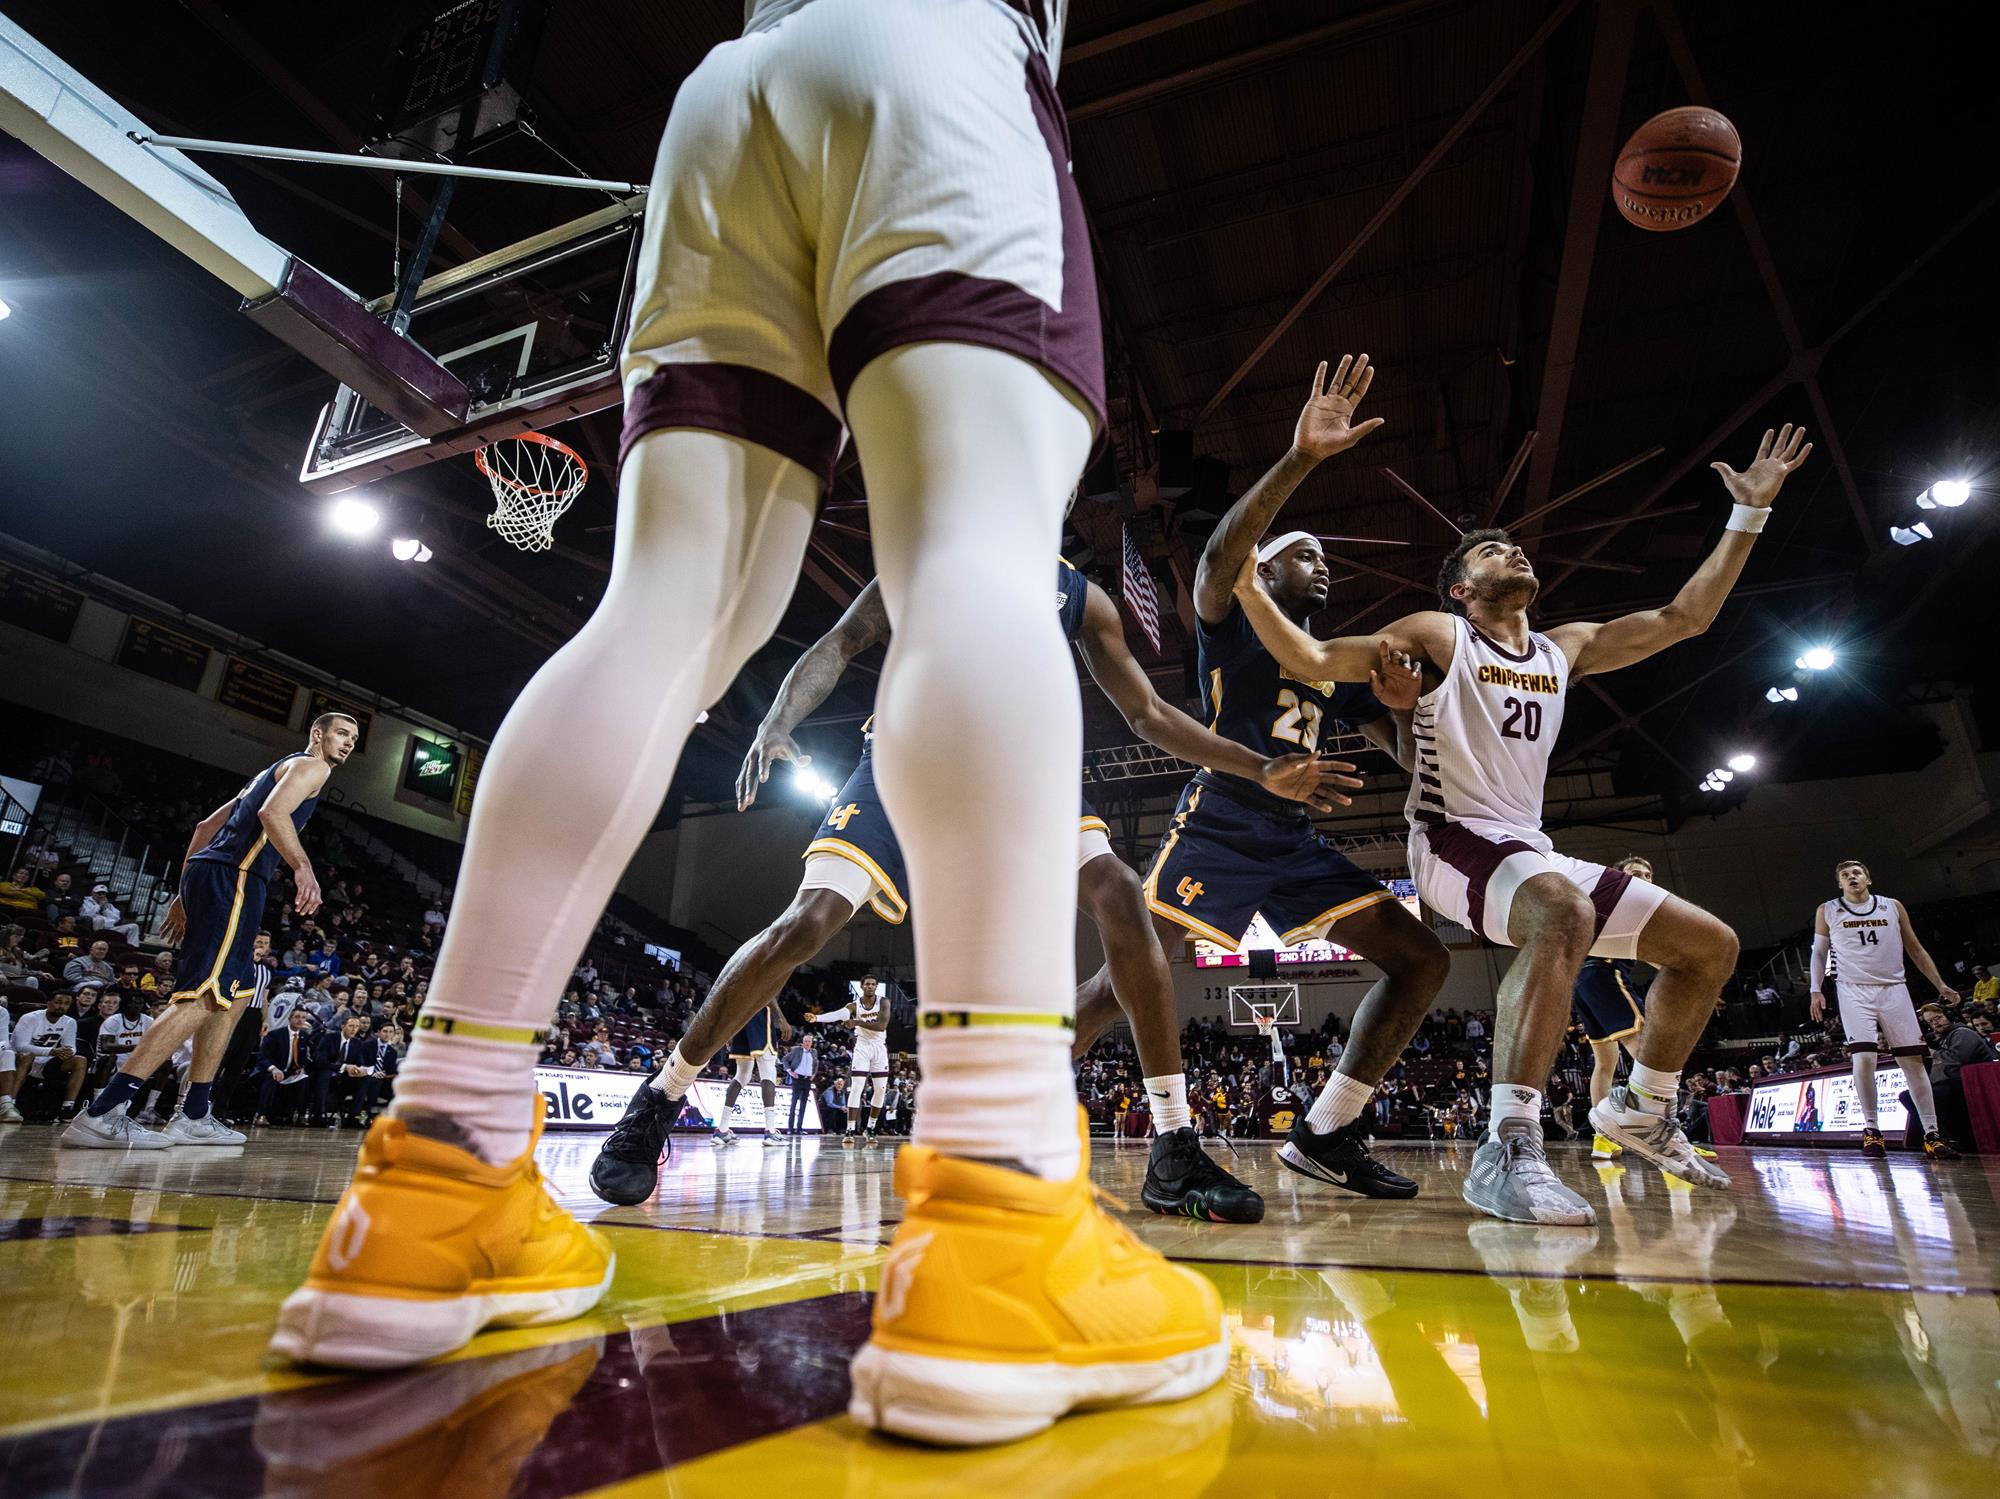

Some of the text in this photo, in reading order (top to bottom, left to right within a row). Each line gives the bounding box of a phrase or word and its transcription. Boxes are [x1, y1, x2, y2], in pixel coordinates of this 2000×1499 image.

[1479, 665, 1559, 695] CHIPPEWAS
[1501, 696, 1542, 742] 20
[1842, 918, 1889, 929] CHIPPEWAS
[1857, 929, 1879, 946] 14
[1279, 950, 1333, 962] 2ND 17:36
[1318, 967, 1360, 978] ARENA
[541, 1082, 594, 1120] ale
[1750, 1096, 1776, 1130] Wale
